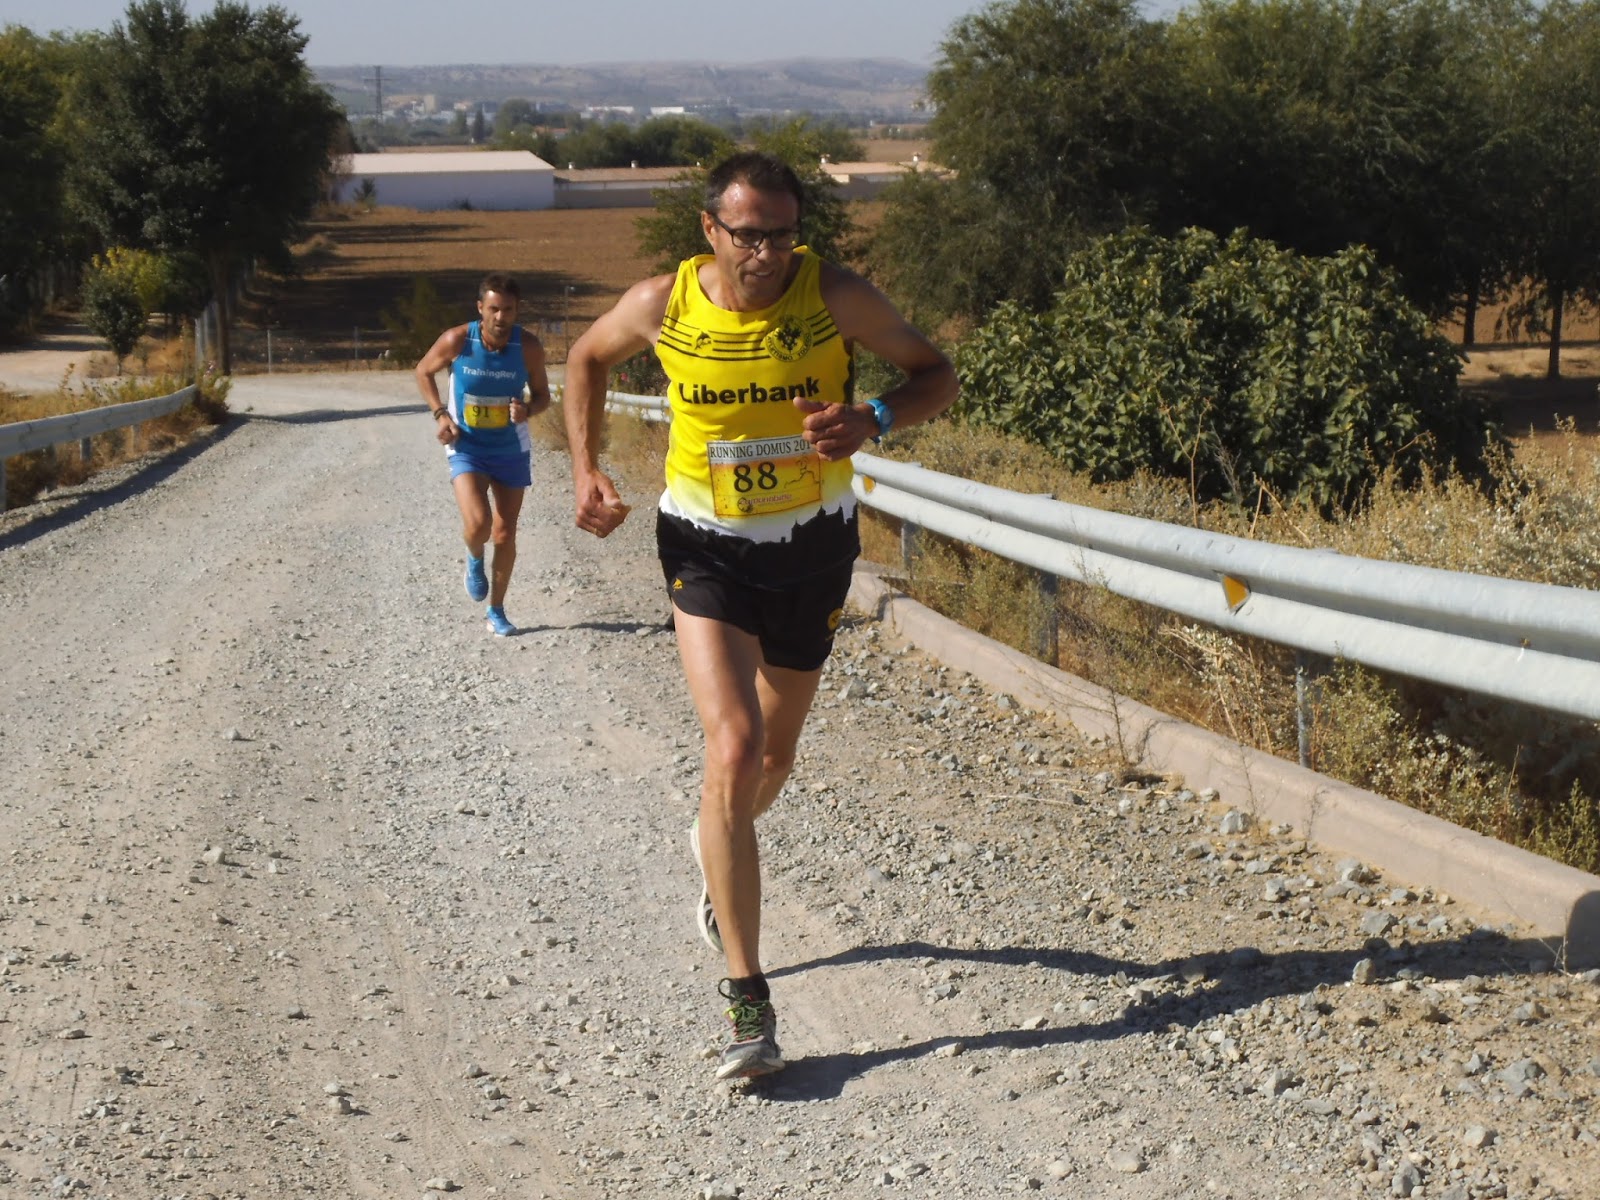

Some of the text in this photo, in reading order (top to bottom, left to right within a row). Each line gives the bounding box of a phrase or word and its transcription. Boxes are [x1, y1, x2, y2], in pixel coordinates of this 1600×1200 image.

[679, 376, 820, 404] Liberbank
[472, 405, 489, 418] 91
[710, 438, 811, 459] RUNNING DOMUS 201
[733, 461, 778, 493] 88
